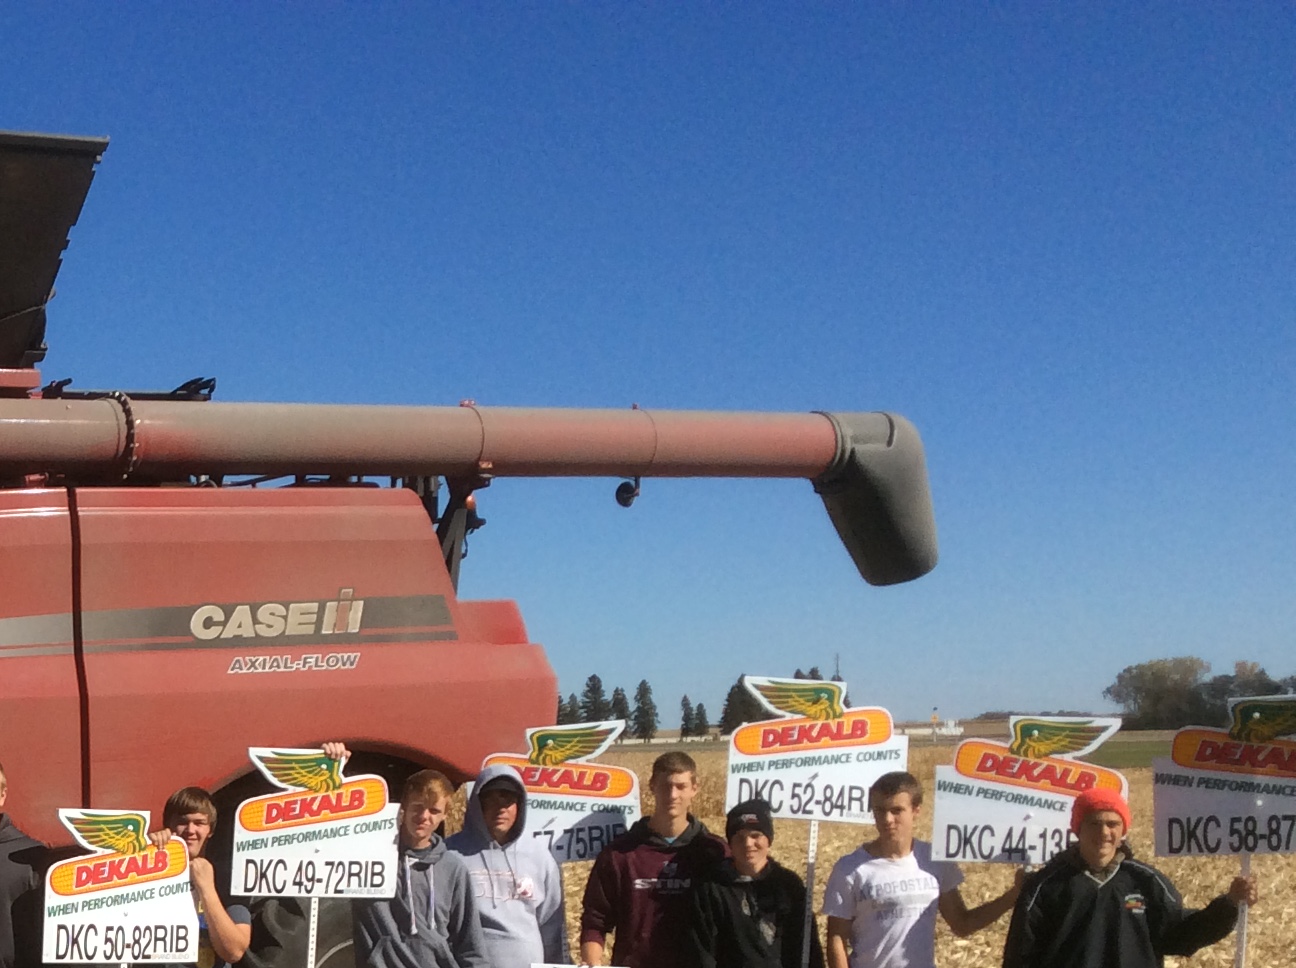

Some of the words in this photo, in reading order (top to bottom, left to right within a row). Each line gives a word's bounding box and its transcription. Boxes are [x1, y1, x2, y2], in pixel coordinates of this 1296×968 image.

[190, 602, 319, 640] CASE
[227, 653, 361, 674] AXIAL-FLOW
[761, 719, 869, 749] DEKALB
[731, 760, 770, 774] WHEN
[768, 752, 852, 771] PERFORMANCE
[856, 749, 901, 763] COUNTS
[976, 752, 1097, 792] DEKALB
[1194, 739, 1296, 772] DEKA
[738, 777, 784, 814] DKC
[789, 781, 874, 818] 52-84RI
[937, 780, 975, 797] WHEN
[975, 784, 1068, 812] PERFORMANCE
[1155, 773, 1195, 788] WHEN
[1196, 776, 1296, 797] PERFORMANCE
[265, 788, 365, 825] DEKALB
[590, 802, 635, 815] COUNTS
[235, 837, 269, 853] WHEN
[270, 825, 350, 848] PERFORMANCE
[353, 817, 395, 835] COUNTS
[945, 824, 996, 860] DKC
[1167, 815, 1222, 854] DKC
[74, 850, 169, 889] DEKALB
[243, 858, 288, 895] DKC
[292, 860, 386, 895] 49-72RIB
[47, 901, 79, 918] WHEN
[81, 887, 155, 912] PERFORMANCE
[55, 923, 99, 961] DKC
[103, 924, 189, 961] 50-82RIB
